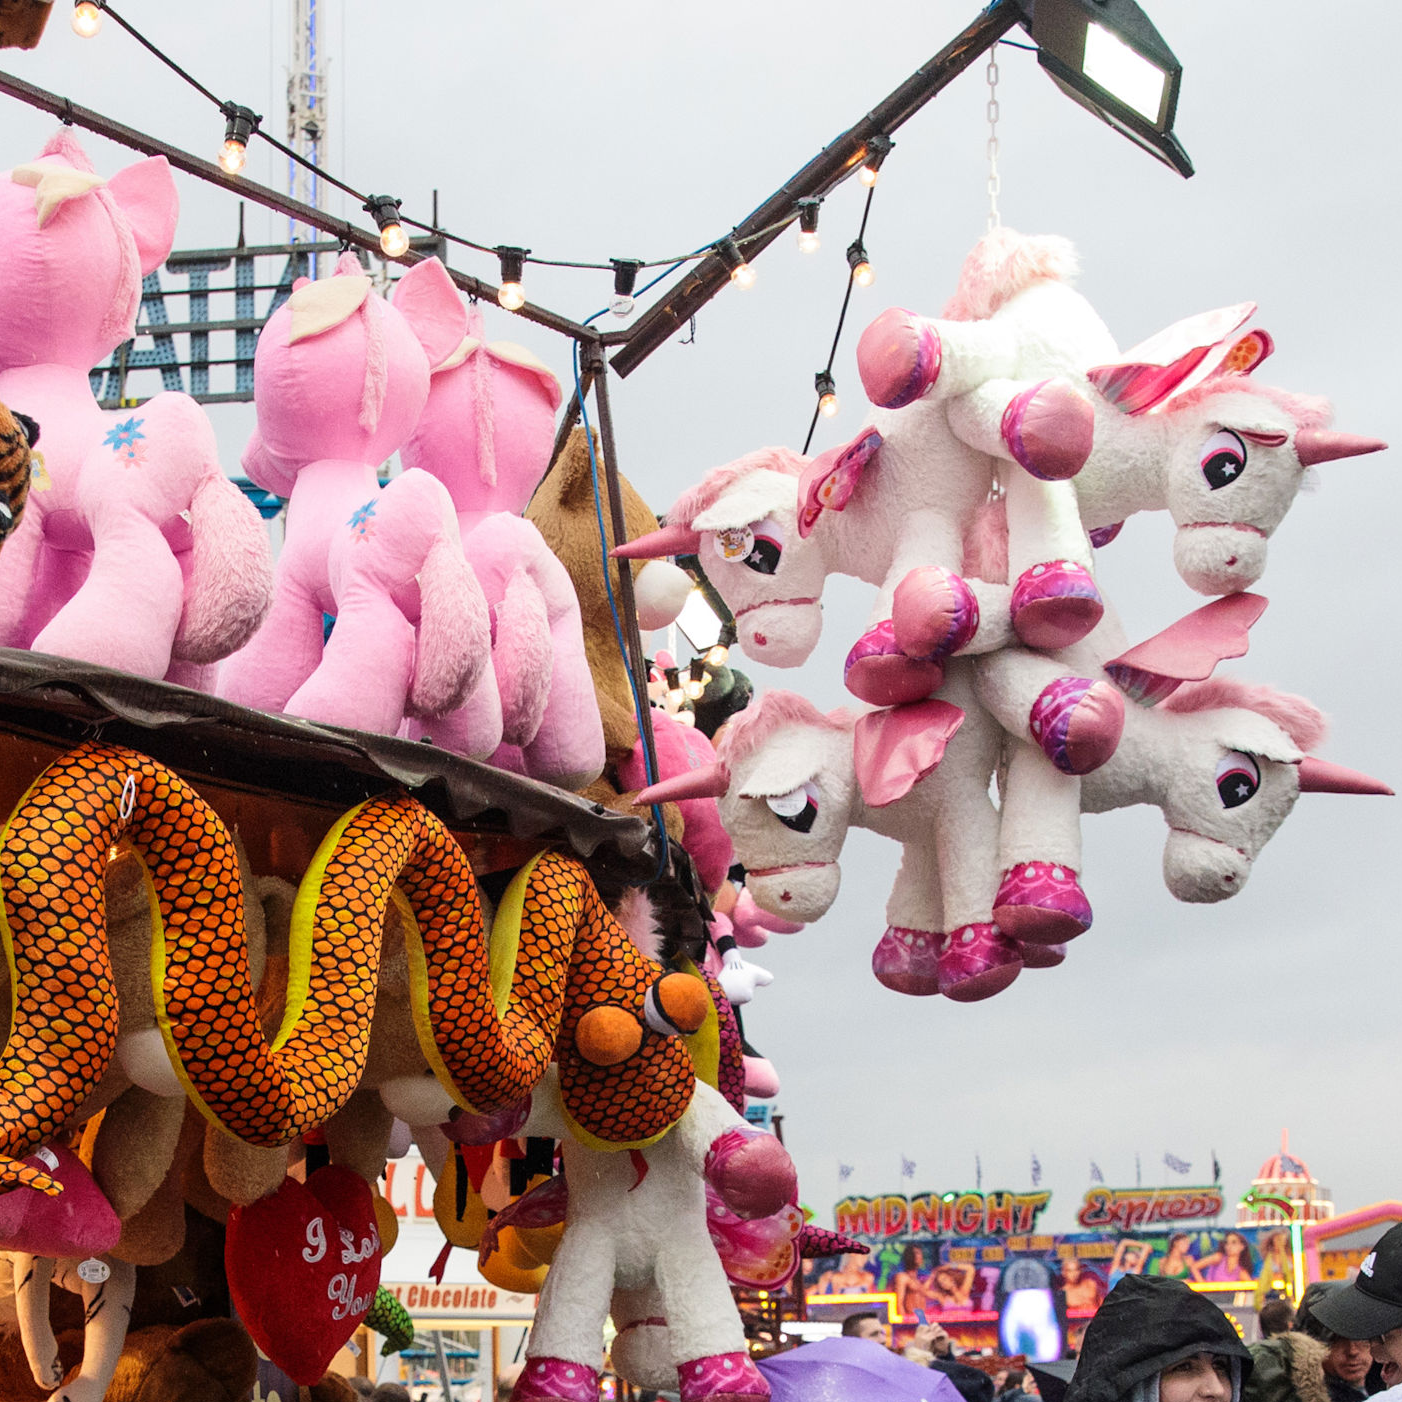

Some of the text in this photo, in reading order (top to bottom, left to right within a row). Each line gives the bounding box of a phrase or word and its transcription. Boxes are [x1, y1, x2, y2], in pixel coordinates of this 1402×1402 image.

[835, 1186, 1225, 1237] MIDNIGHT Express
[407, 1285, 498, 1309] Chocolate
